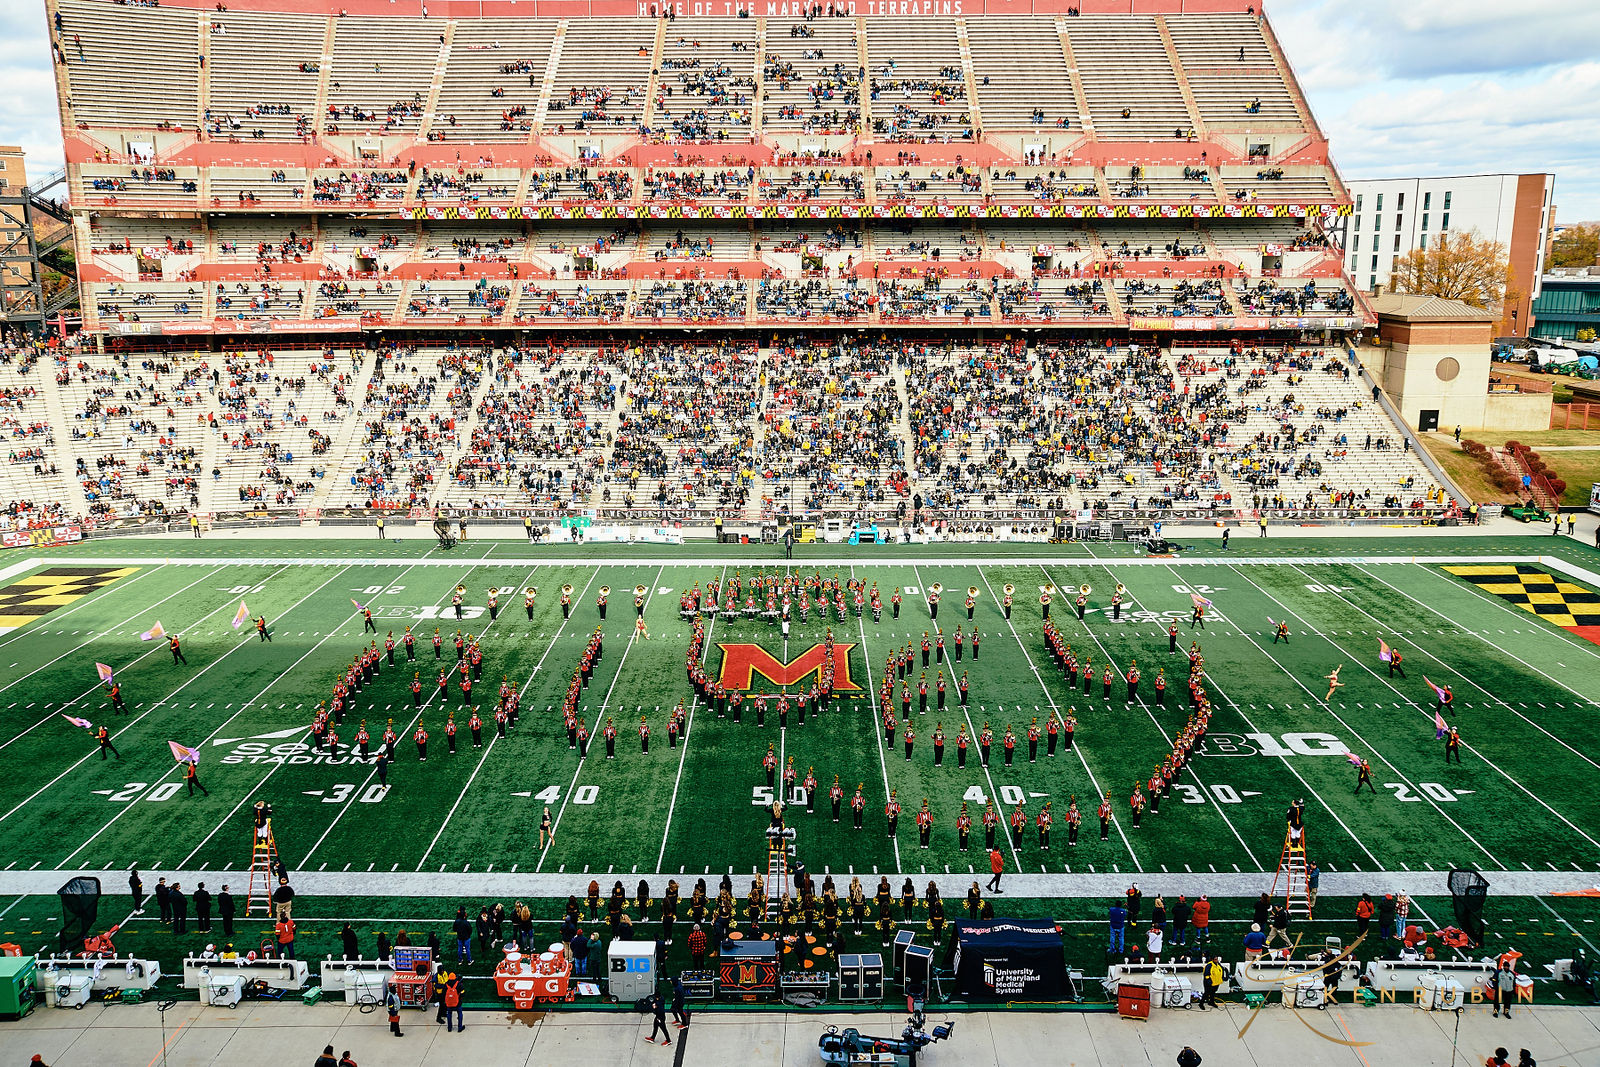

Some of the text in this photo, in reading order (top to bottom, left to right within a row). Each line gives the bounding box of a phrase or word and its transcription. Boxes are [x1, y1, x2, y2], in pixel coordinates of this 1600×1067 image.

[639, 1, 962, 16] HOME OF THE MARYLAND TERRAPINS
[119, 322, 150, 333] VICTORY
[362, 585, 406, 594] 20
[1171, 584, 1215, 594] 20
[1304, 584, 1342, 593] 10
[713, 642, 867, 691] M
[108, 783, 184, 801] 20
[321, 784, 391, 803] 30
[534, 785, 600, 805] 40
[752, 786, 808, 805] 50
[963, 786, 1027, 805] 40
[1175, 784, 1243, 803] 30
[1383, 783, 1458, 802] 20
[994, 924, 1021, 932] SPORTS
[739, 964, 758, 984] M
[996, 968, 1034, 976] University
[1006, 974, 1040, 982] Maryland
[545, 979, 560, 993] G
